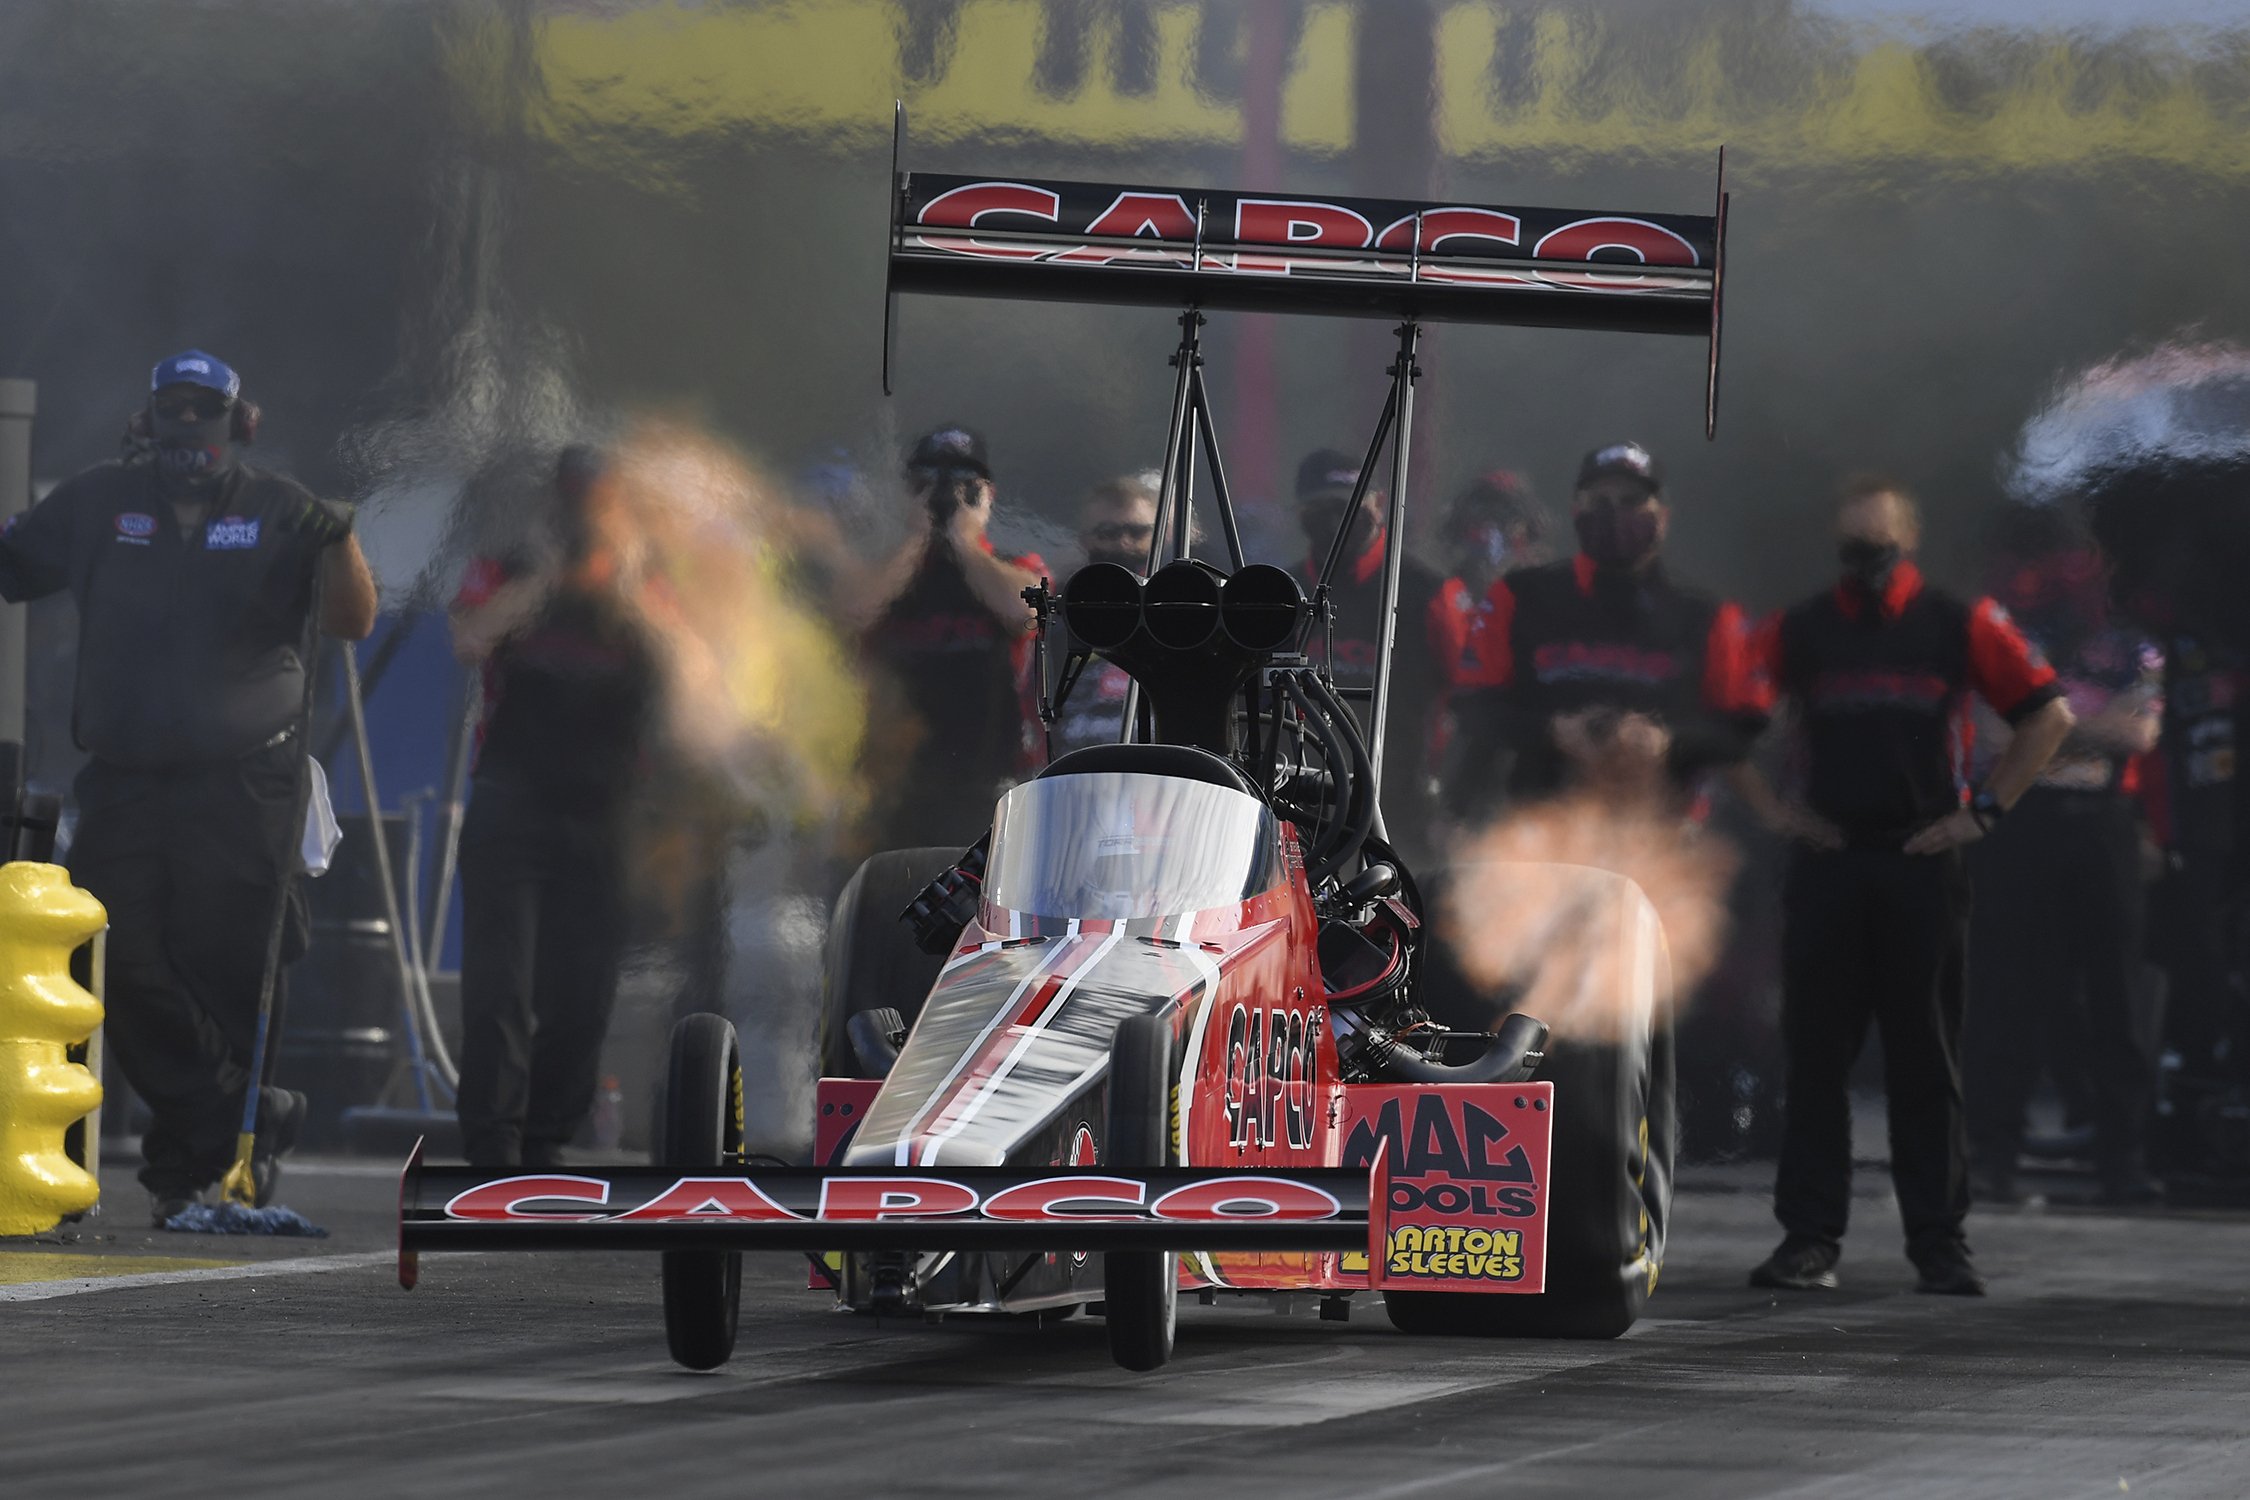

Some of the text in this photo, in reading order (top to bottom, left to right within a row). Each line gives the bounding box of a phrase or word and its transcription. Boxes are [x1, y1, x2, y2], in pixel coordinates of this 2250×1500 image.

[916, 181, 1700, 293] CAPCO
[207, 533, 258, 546] WORLD
[1223, 1002, 1317, 1150] CAPCO
[1341, 1094, 1534, 1184] MAC
[444, 1174, 1341, 1222] CAPCO
[1389, 1182, 1537, 1218] OOLS
[1390, 1251, 1521, 1278] SLEEVES
